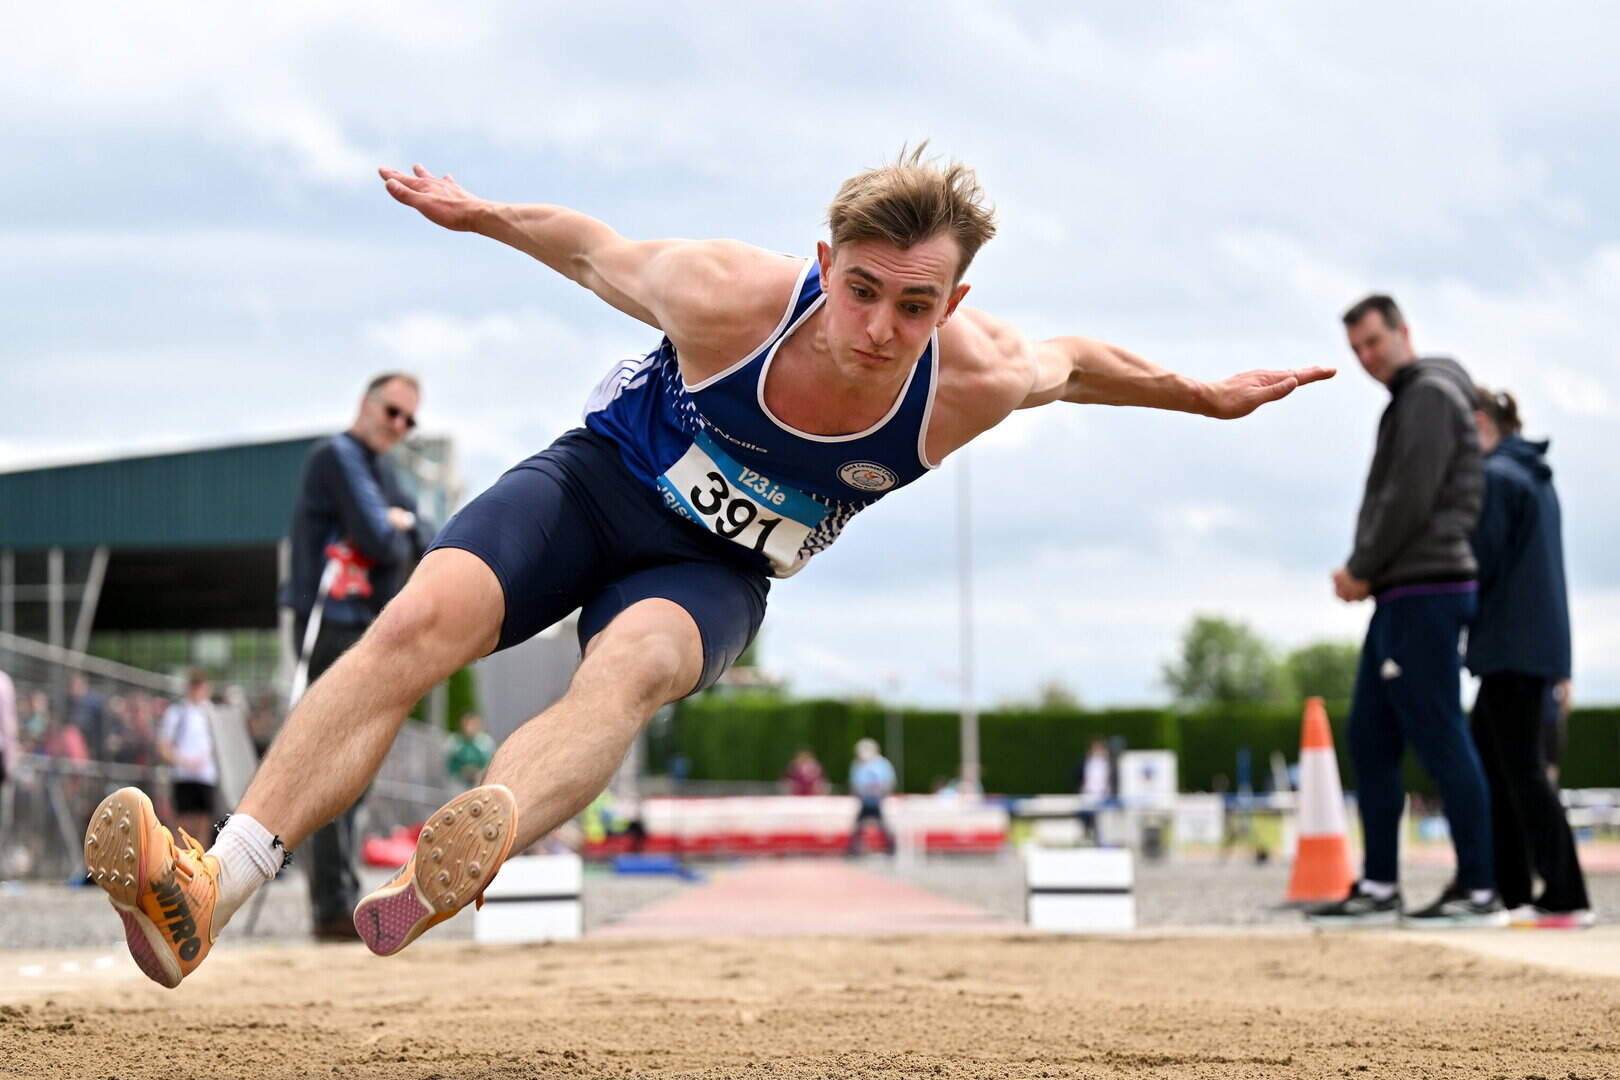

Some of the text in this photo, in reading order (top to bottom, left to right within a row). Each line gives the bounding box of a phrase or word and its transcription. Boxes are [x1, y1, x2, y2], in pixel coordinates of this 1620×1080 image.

[690, 471, 783, 553] 391
[738, 466, 786, 505] 123.ie
[150, 881, 202, 962] NITRO
